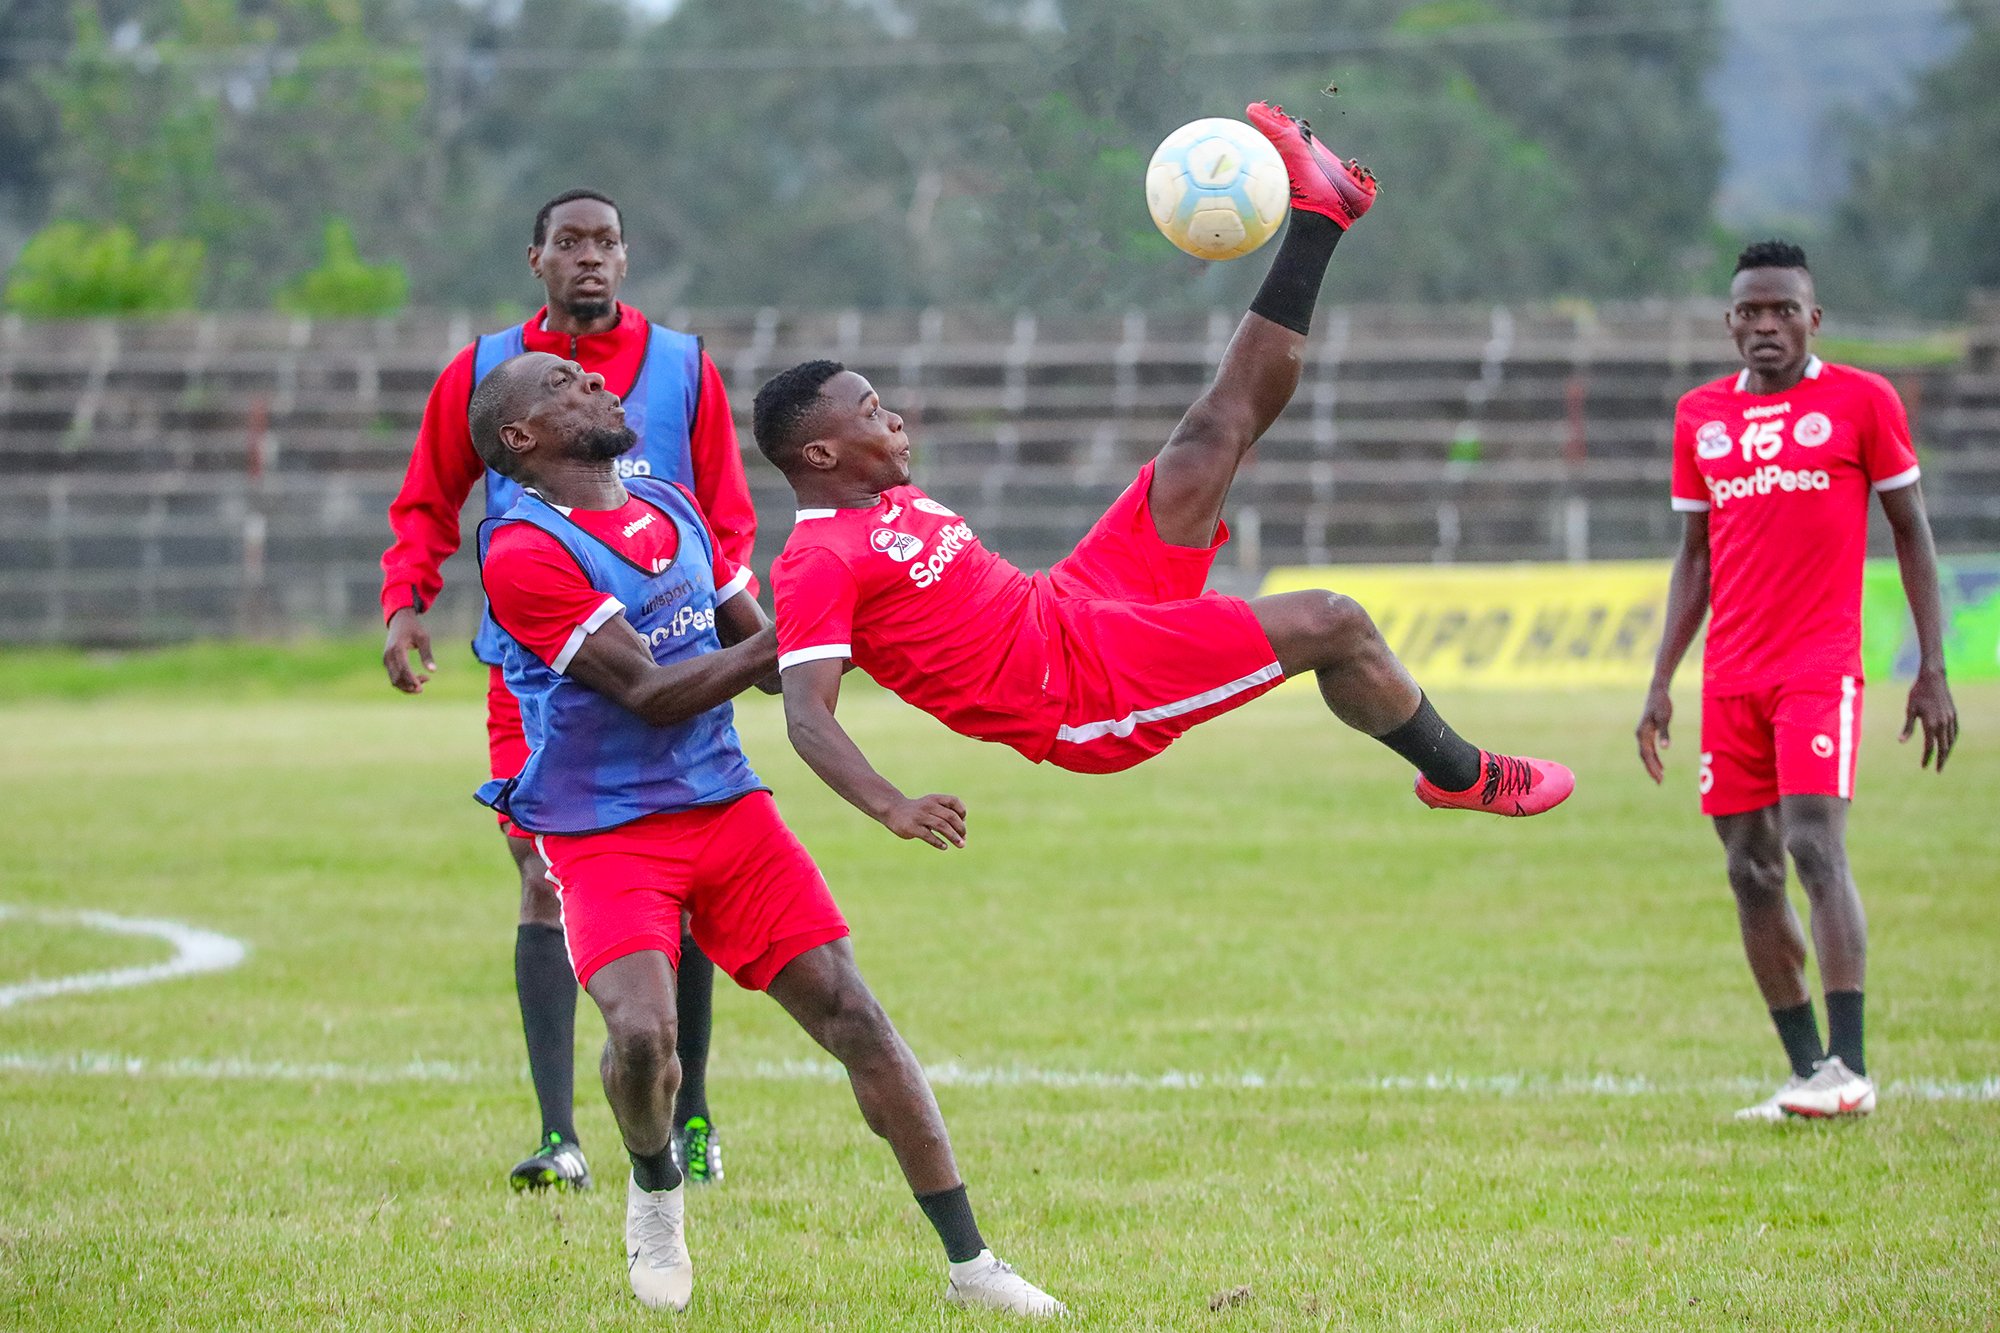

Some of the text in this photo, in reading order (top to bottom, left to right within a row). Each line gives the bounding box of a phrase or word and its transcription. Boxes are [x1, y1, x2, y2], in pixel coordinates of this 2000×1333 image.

[1739, 419, 1784, 462] 15
[622, 513, 656, 538] uhlsport
[909, 522, 974, 588] SportPes
